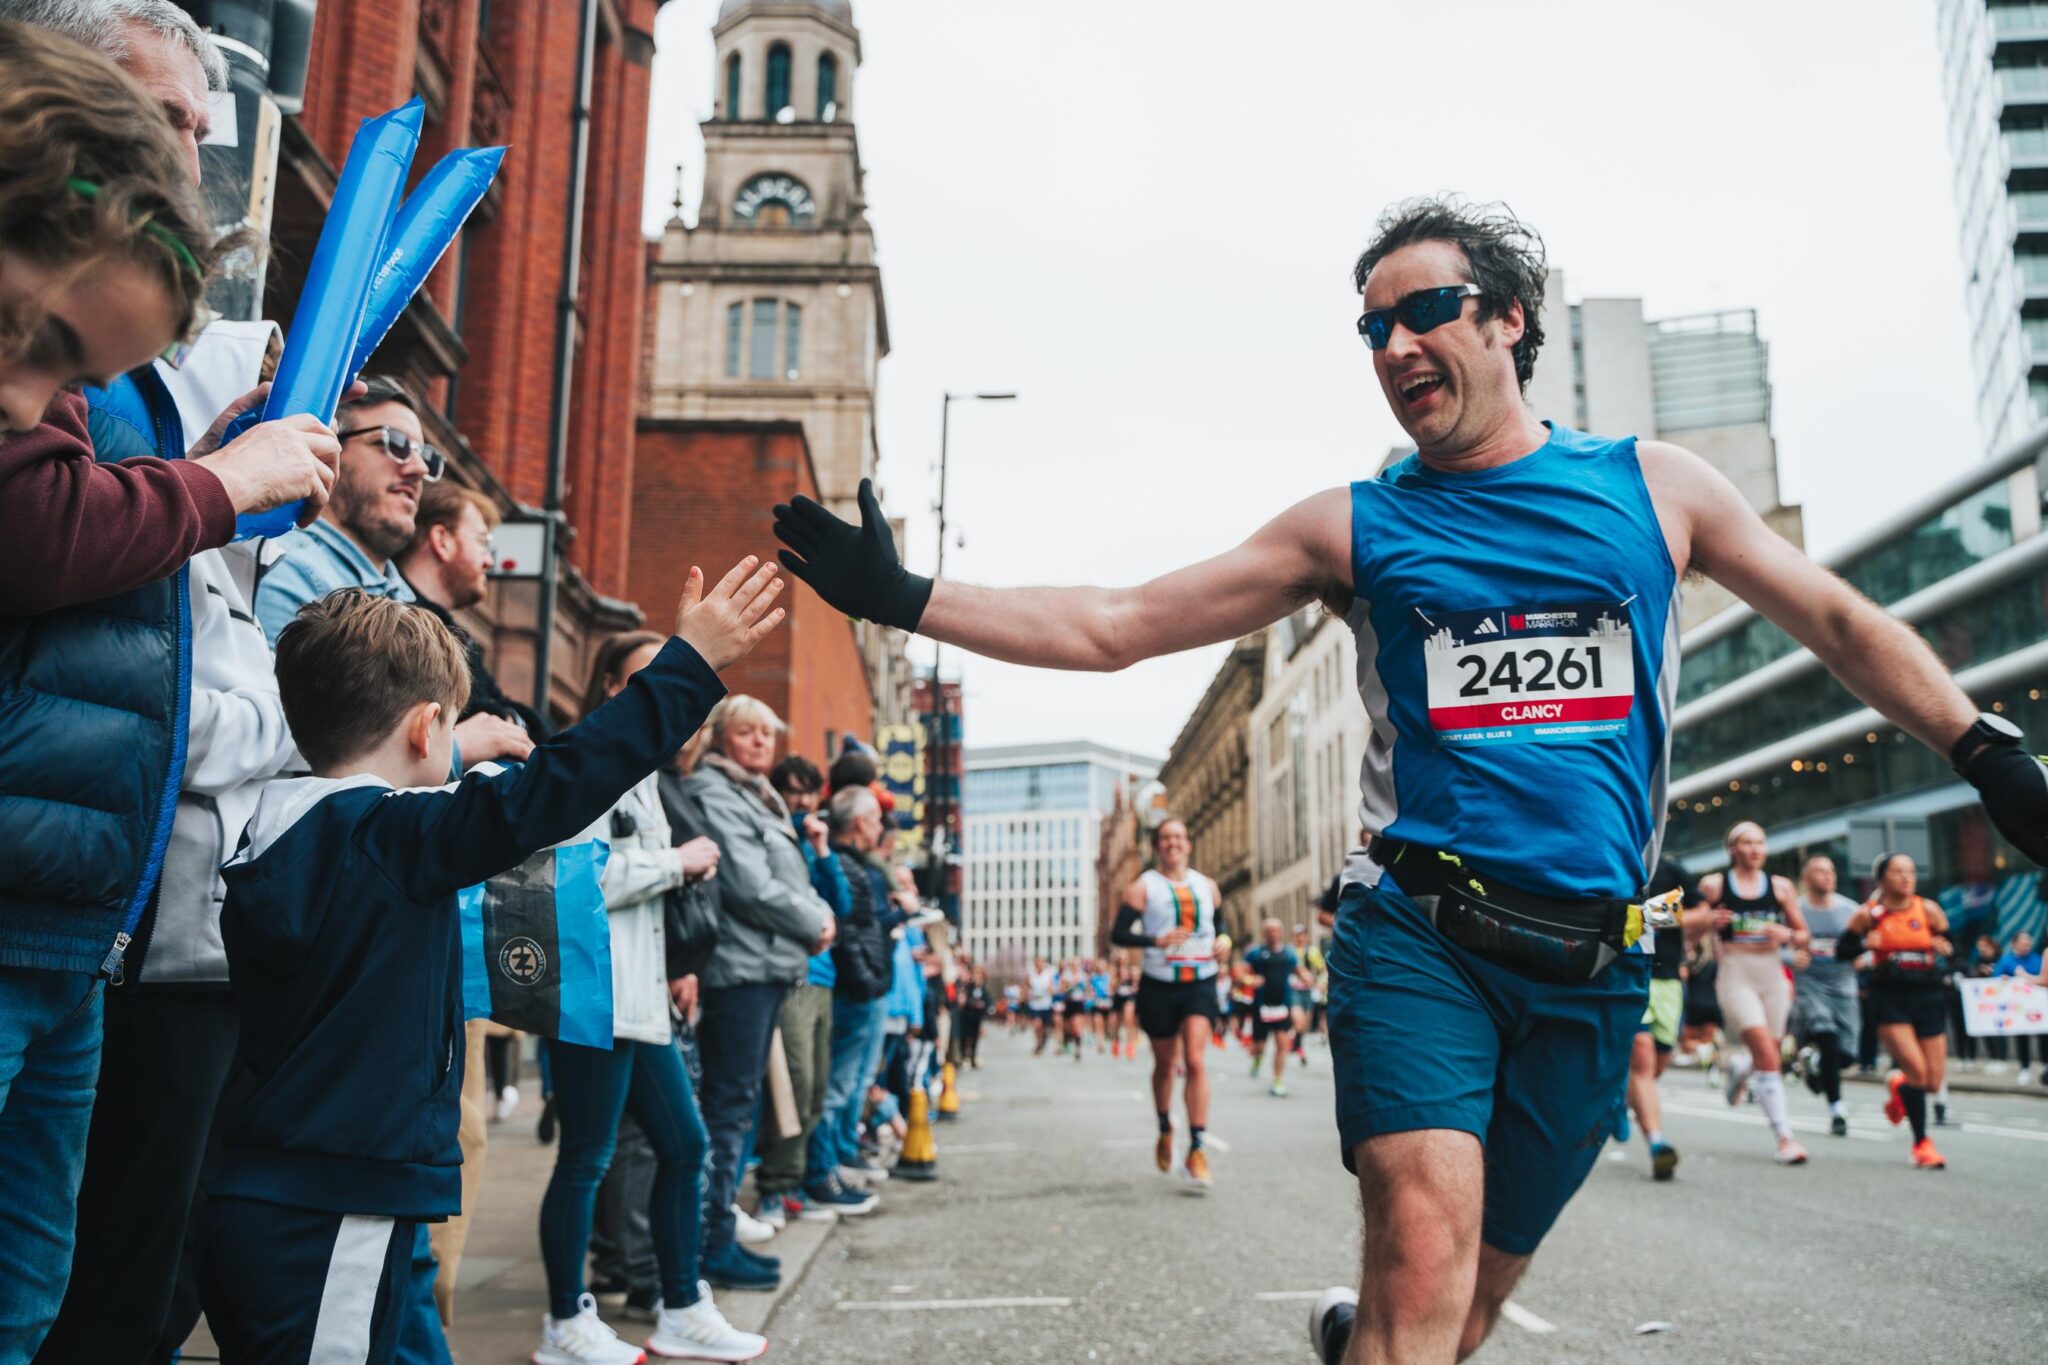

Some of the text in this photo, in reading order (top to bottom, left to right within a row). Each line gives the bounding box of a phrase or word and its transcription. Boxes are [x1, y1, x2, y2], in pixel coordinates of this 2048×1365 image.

[1525, 612, 1577, 621] MANCHESTER
[1526, 619, 1578, 630] MARATHON
[1456, 646, 1603, 698] 24261
[1501, 703, 1564, 721] CLANCY
[1486, 730, 1506, 739] BLUE
